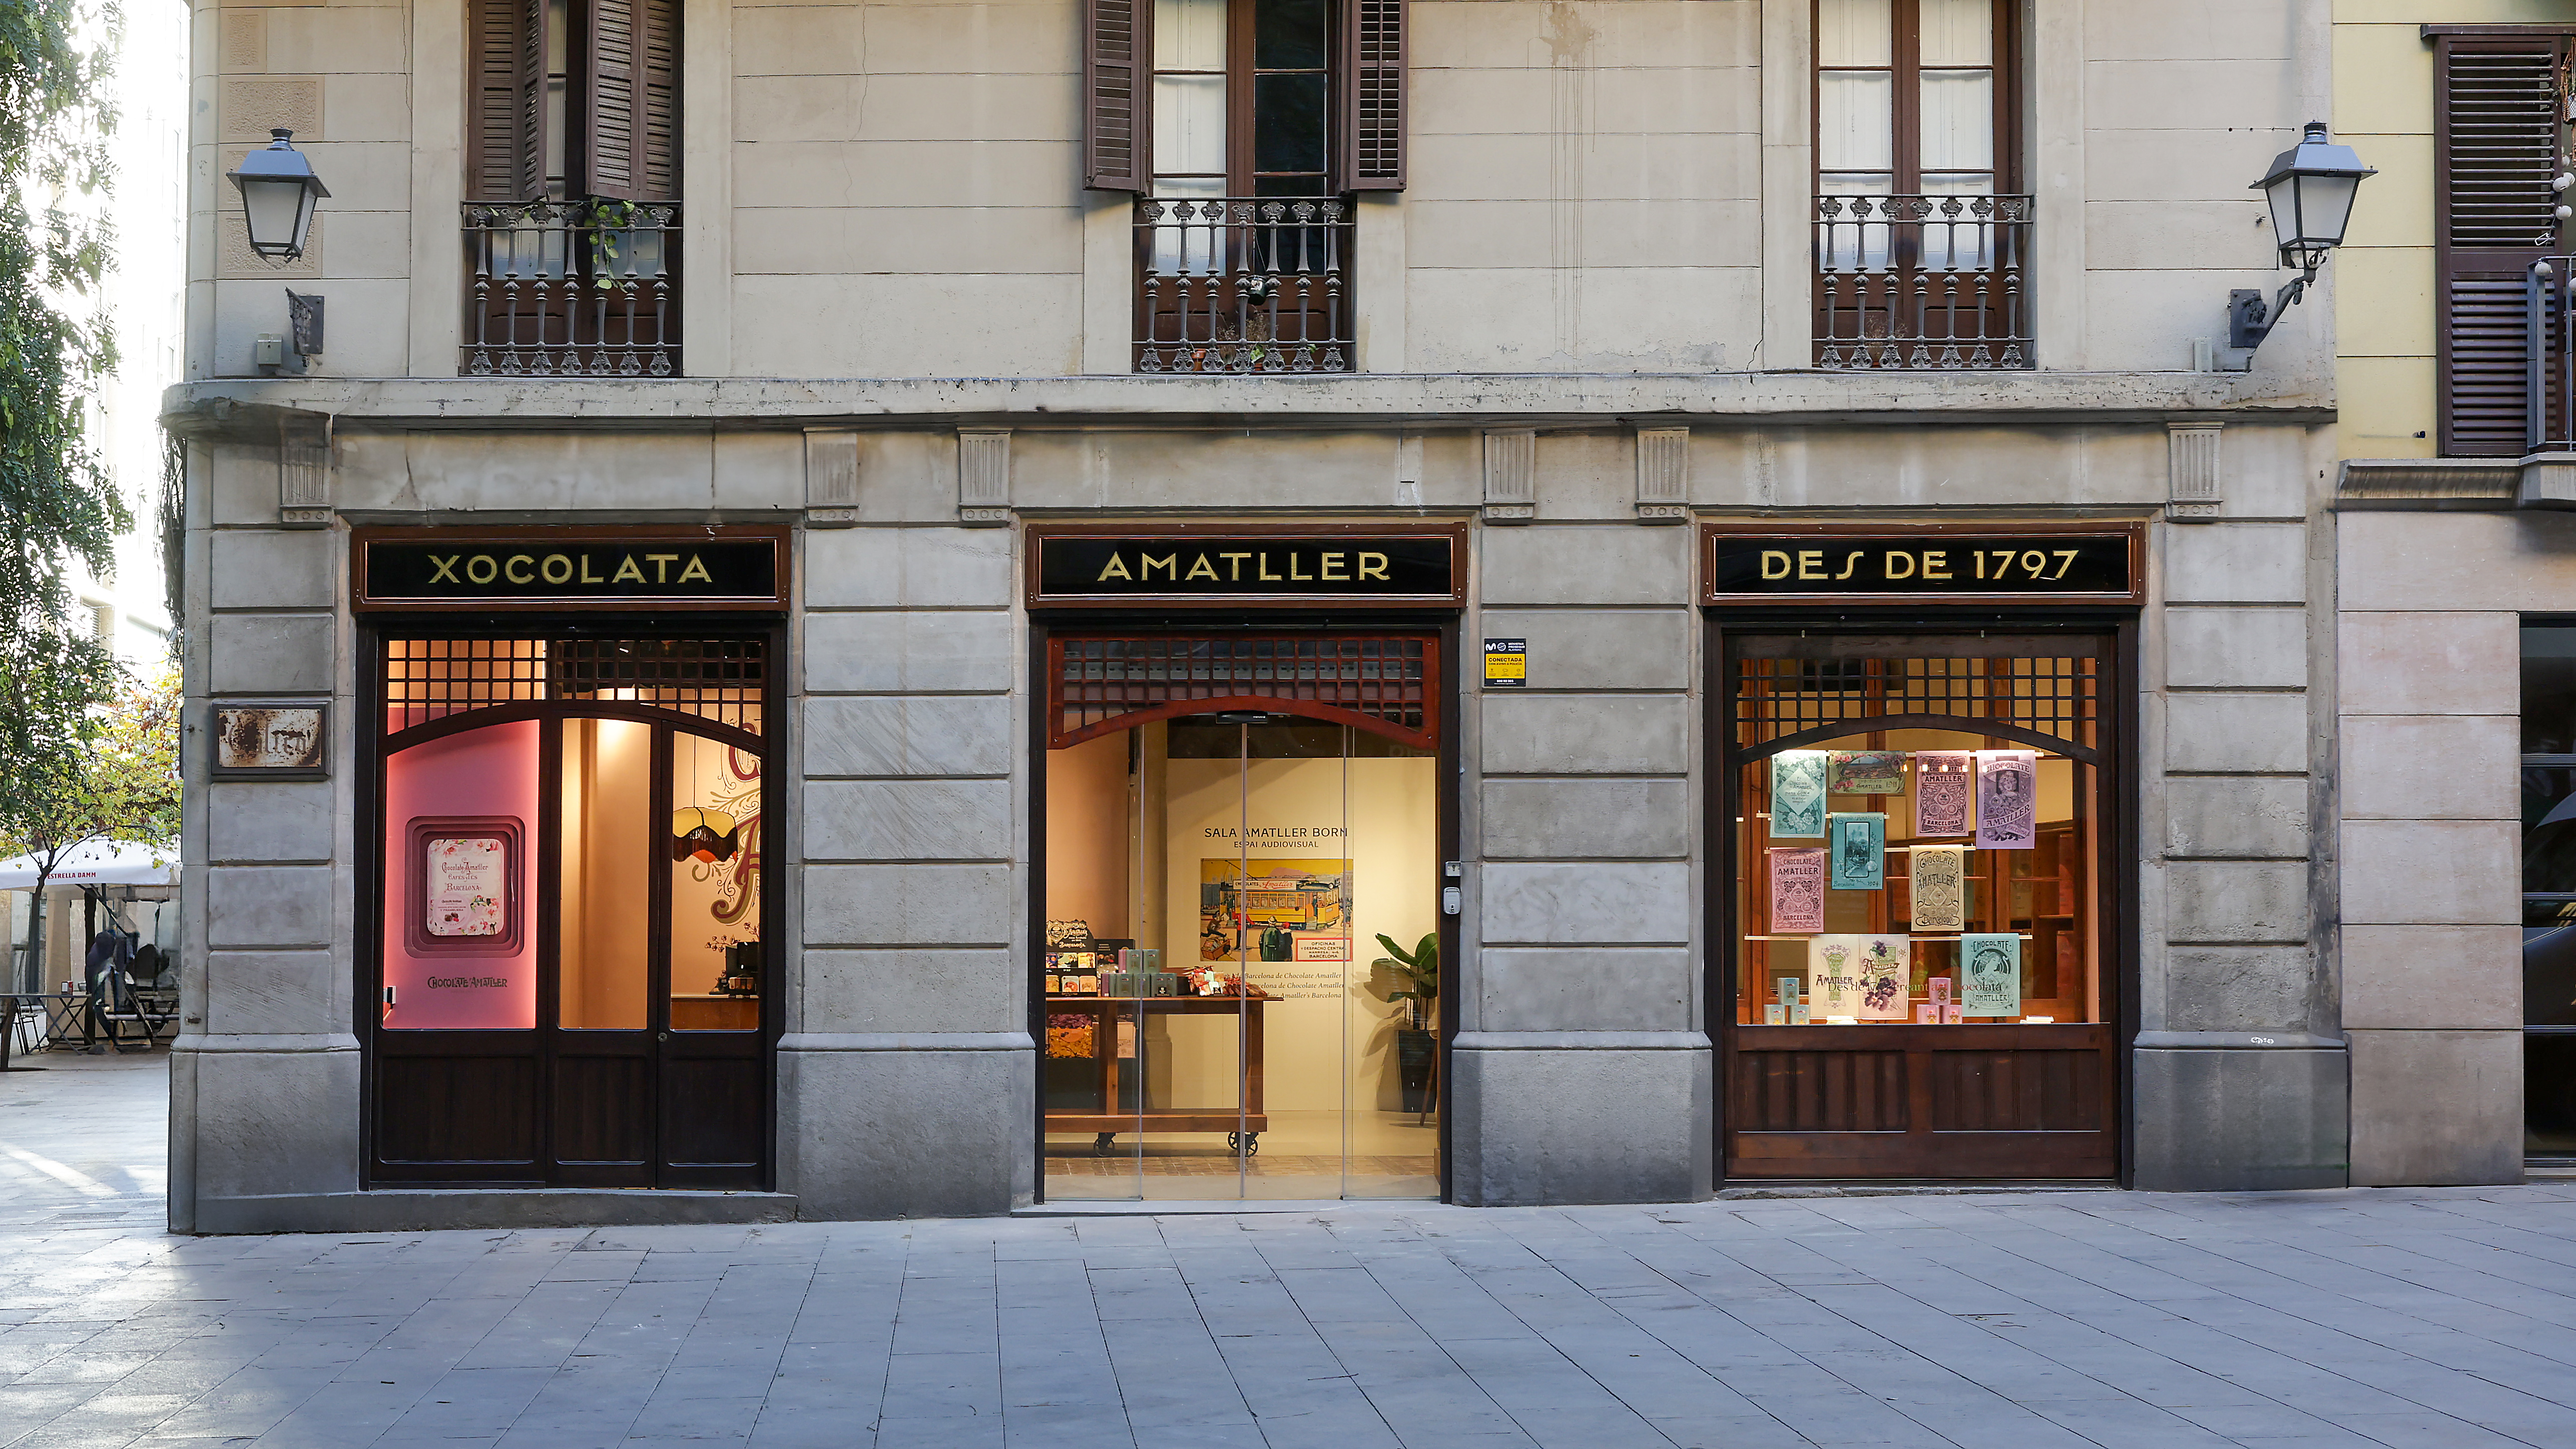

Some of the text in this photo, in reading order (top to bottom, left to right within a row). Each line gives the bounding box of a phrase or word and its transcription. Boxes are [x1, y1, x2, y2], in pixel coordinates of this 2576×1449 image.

[428, 553, 712, 584] XOCOLATA
[1098, 551, 1391, 581] AMATLLER
[1761, 549, 2079, 580] DES DE 1797
[1987, 804, 2031, 827] AMATLLER
[1205, 828, 1237, 837] SALA
[1313, 828, 1347, 837] BORN
[1259, 880, 1293, 889] Amatller
[1974, 941, 2009, 952] CHOCOLATE
[428, 976, 508, 988] CHOCOLATE AMATLLER
[1816, 974, 1854, 985] AMATLLER
[1828, 982, 1848, 991] Des
[1851, 982, 1864, 991] de
